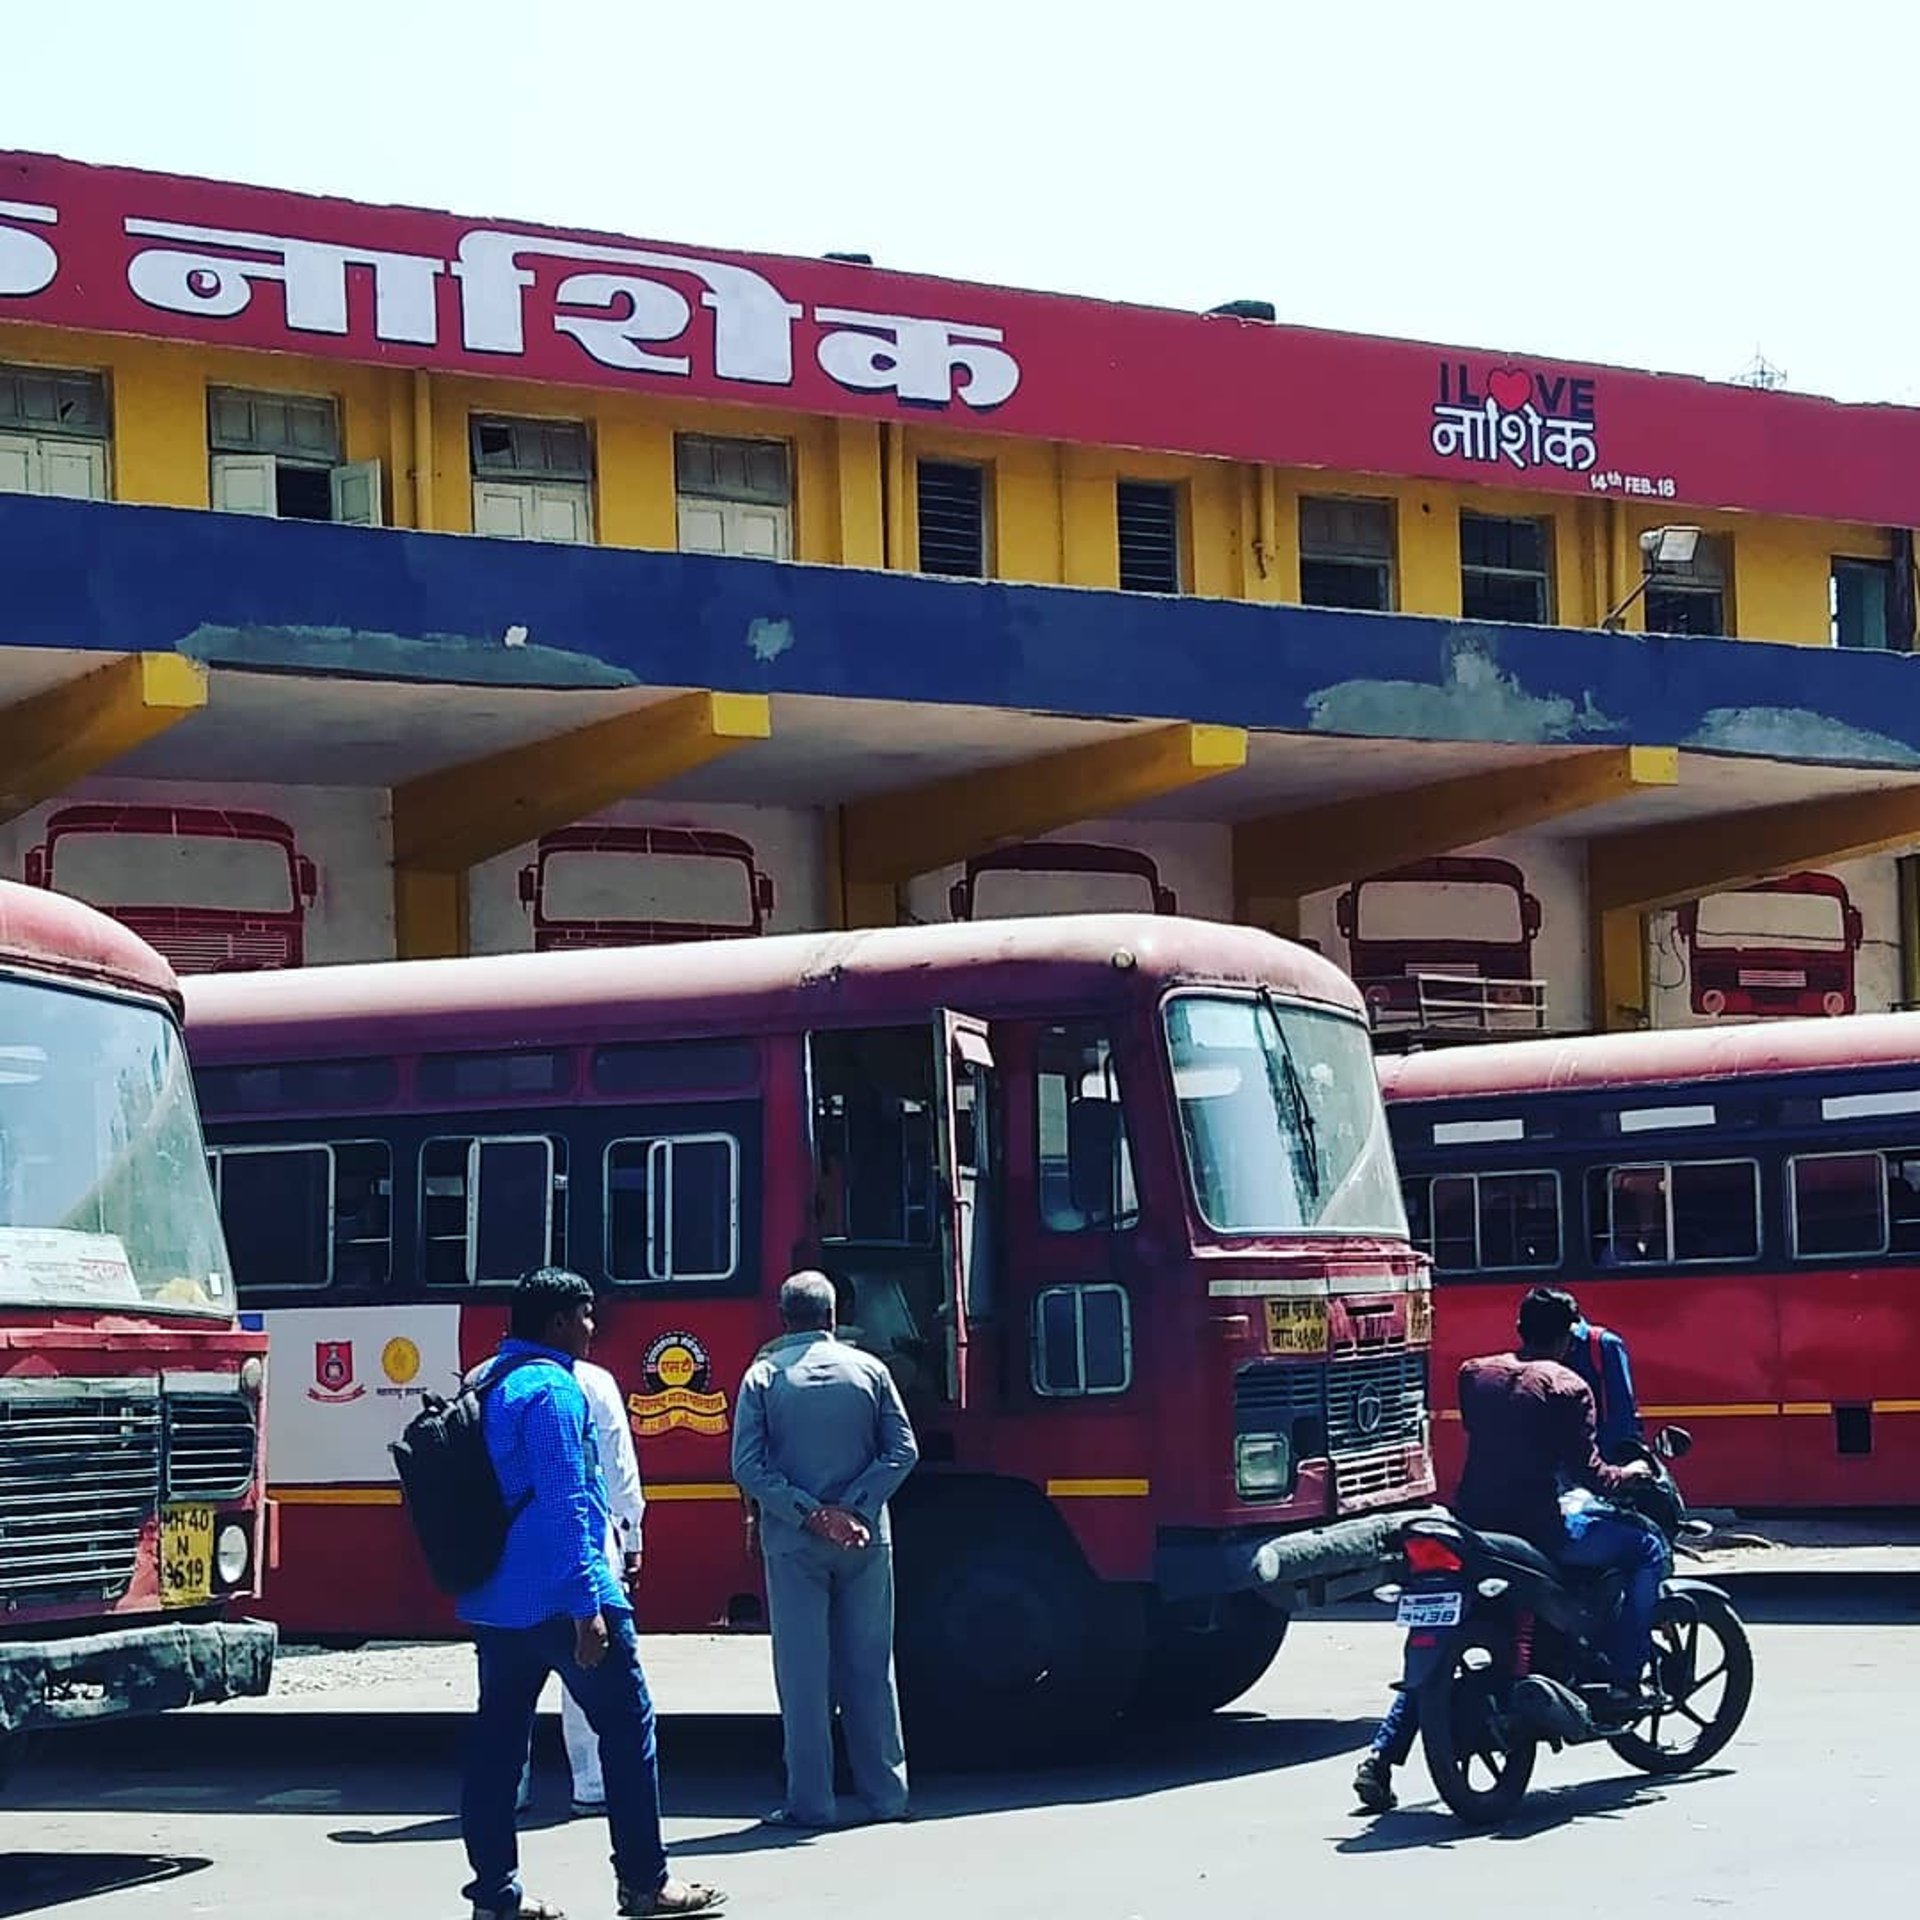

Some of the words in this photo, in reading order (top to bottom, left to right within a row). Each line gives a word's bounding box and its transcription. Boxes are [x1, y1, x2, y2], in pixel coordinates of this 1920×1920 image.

[125, 216, 1021, 410] नाशिक
[1432, 396, 1597, 470] नाशिक
[177, 1535, 189, 1556] N
